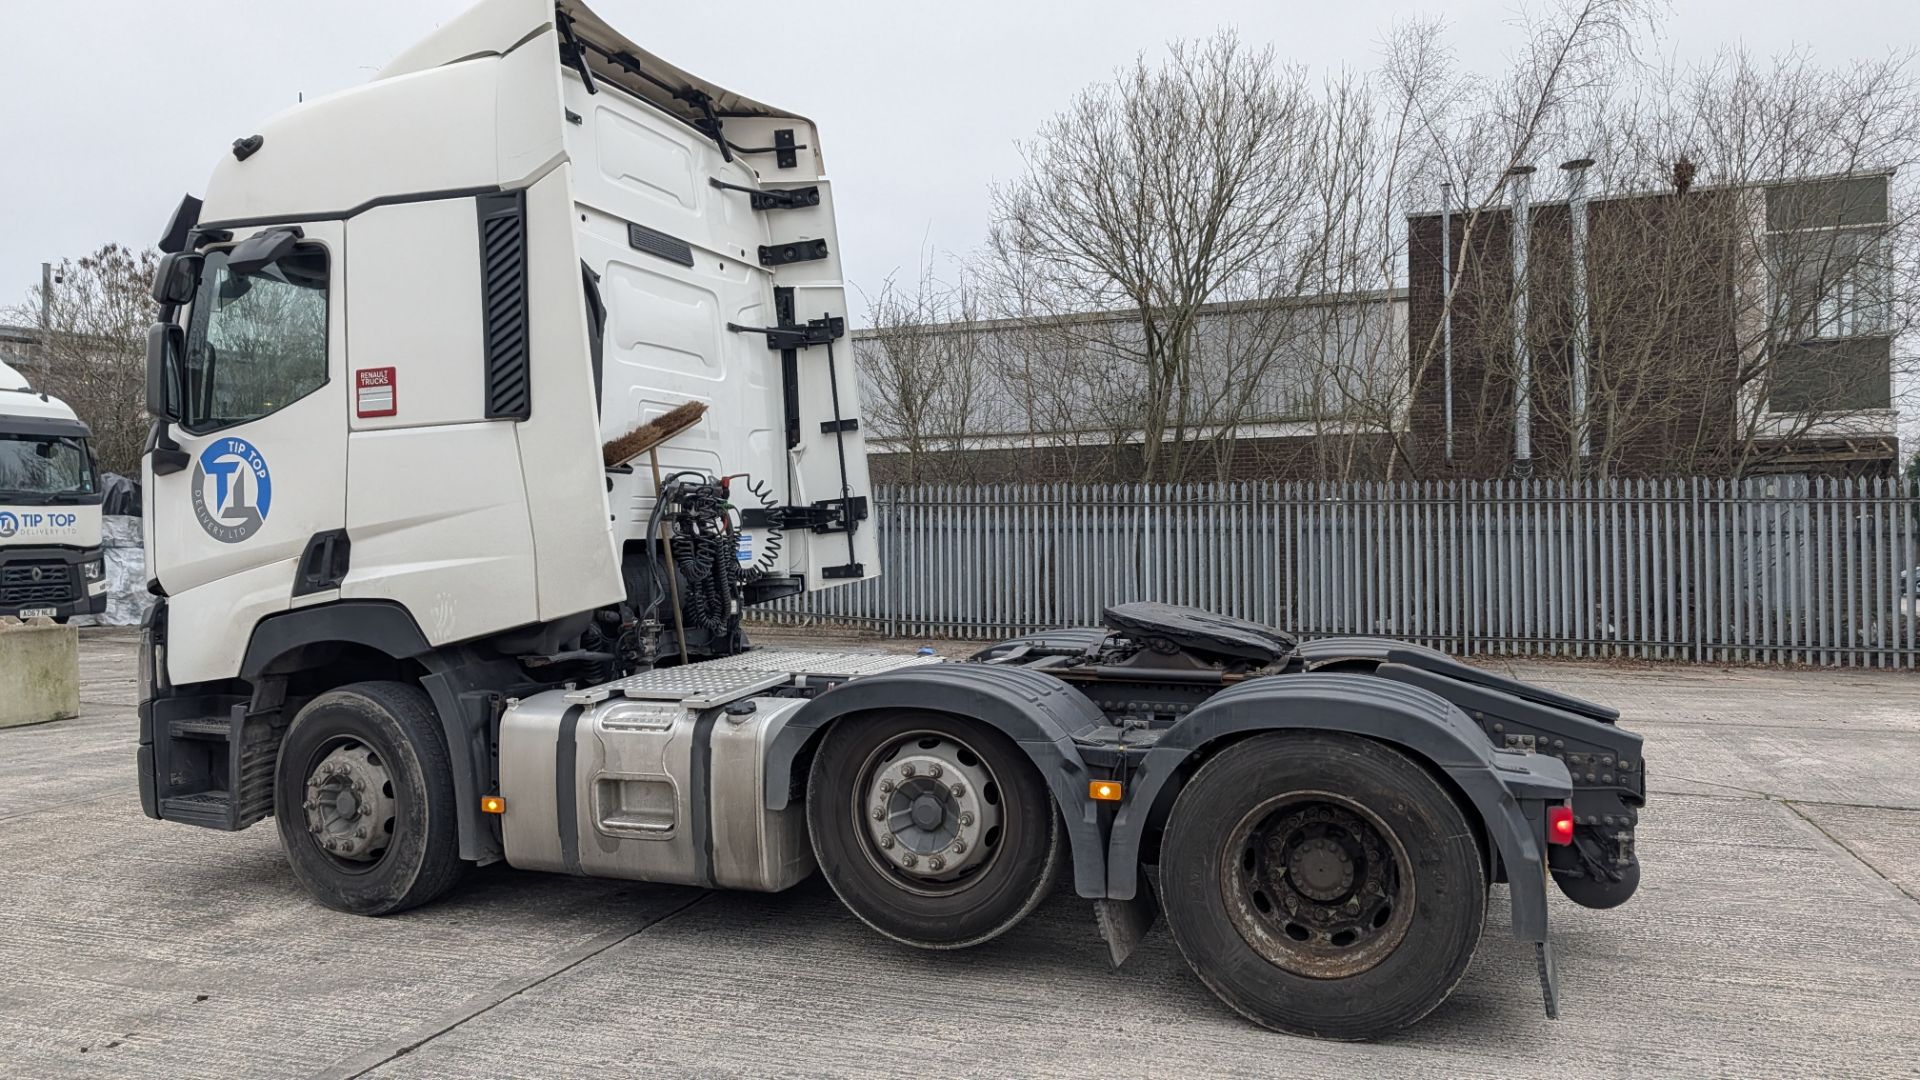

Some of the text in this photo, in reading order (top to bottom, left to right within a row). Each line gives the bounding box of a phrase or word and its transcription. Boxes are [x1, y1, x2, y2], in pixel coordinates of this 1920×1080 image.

[360, 370, 388, 379] RENAULT
[361, 377, 389, 386] TRUCKS
[228, 441, 266, 478] TIP TOP
[195, 489, 246, 539] DELIVERY LTD
[21, 514, 43, 527] TIP
[47, 514, 76, 527] TOP
[20, 528, 59, 536] DELIVERY
